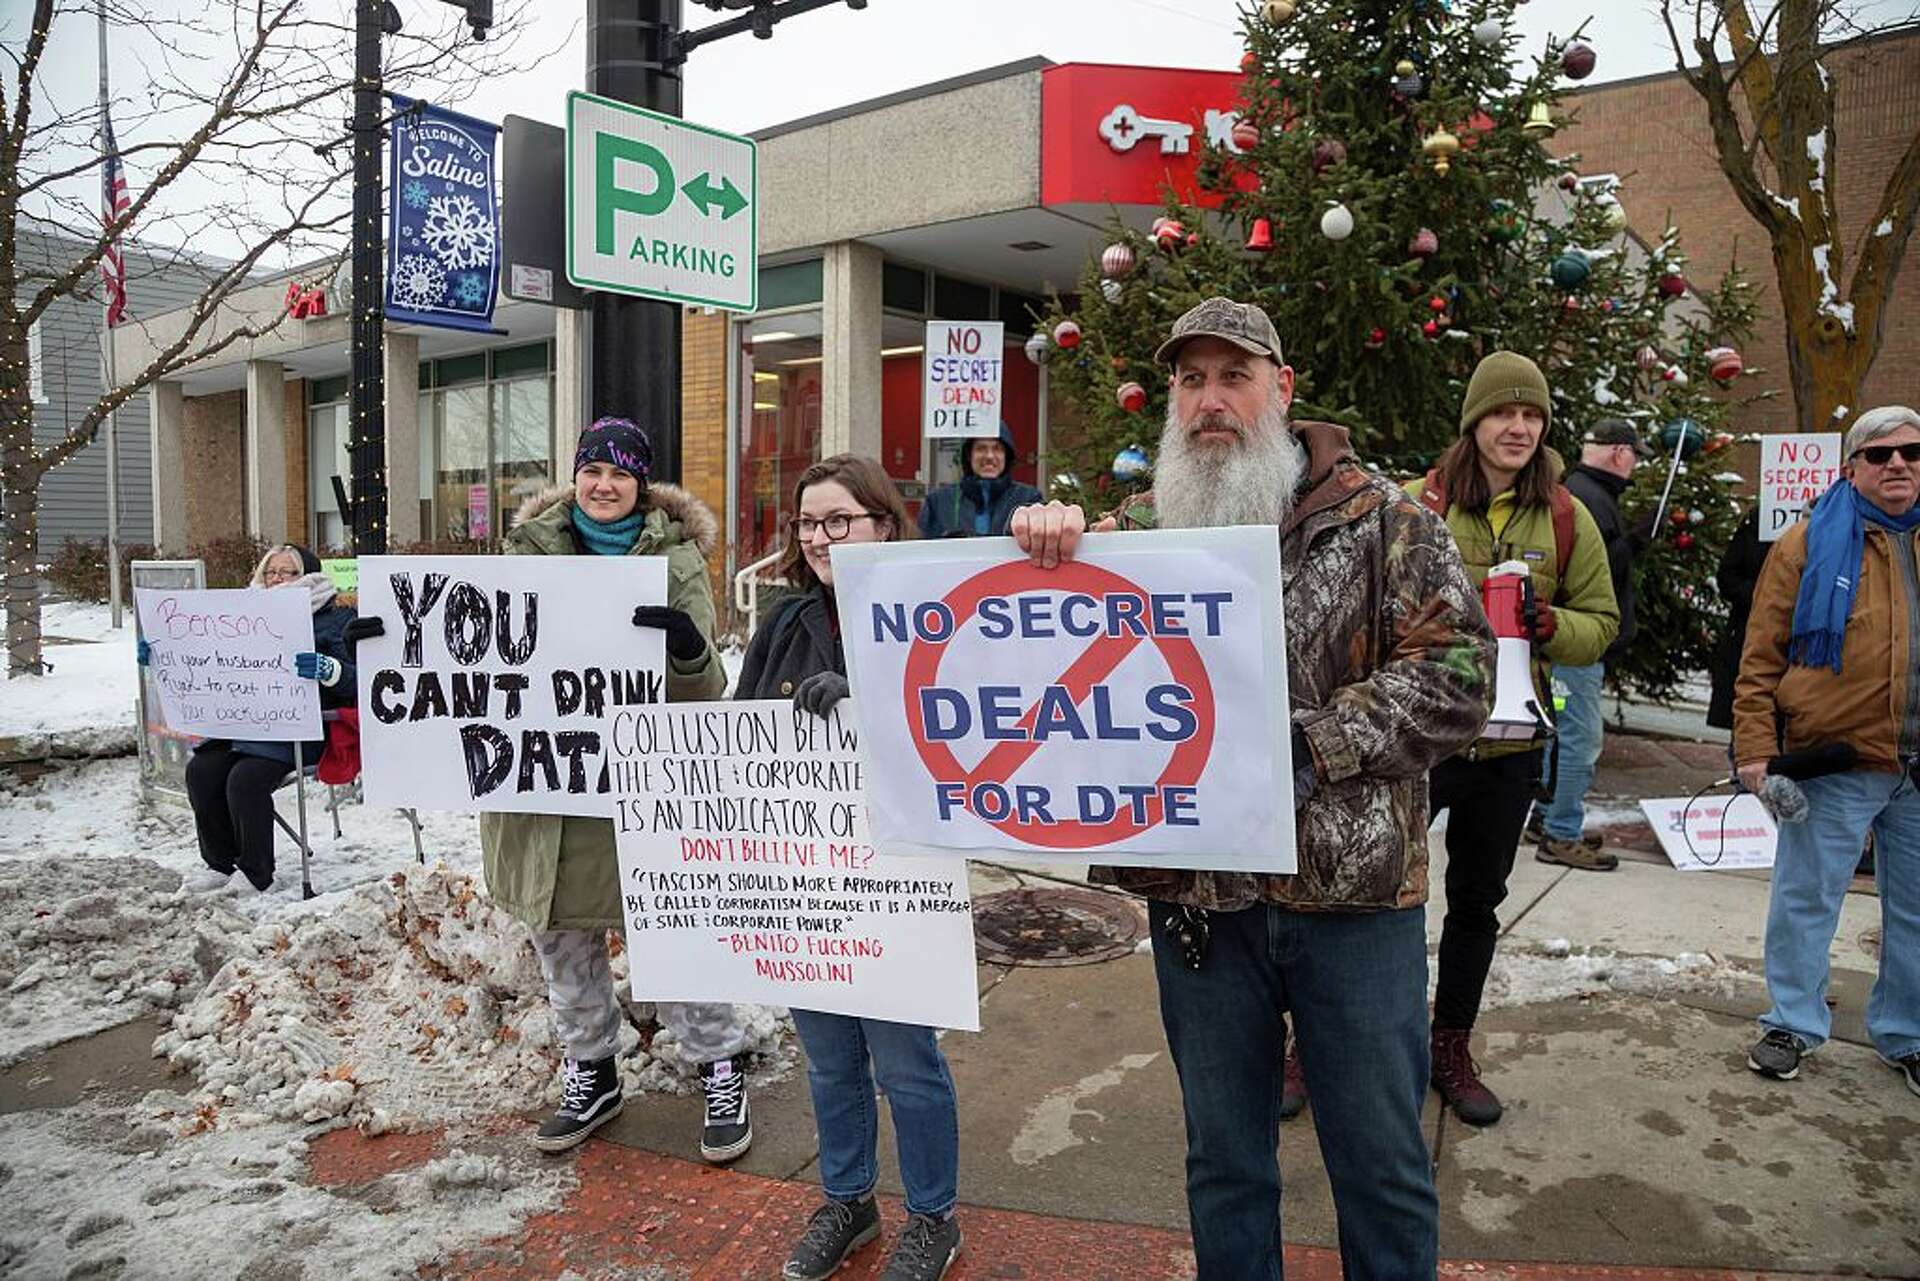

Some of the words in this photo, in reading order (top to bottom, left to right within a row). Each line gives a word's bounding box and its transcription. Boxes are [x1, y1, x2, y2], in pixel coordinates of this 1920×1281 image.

[408, 128, 465, 149] WELCOME
[468, 145, 483, 163] TO
[403, 145, 486, 189] Saline
[947, 327, 981, 355] NO
[931, 358, 1001, 383] SECRET
[943, 387, 996, 405] DEALS
[934, 408, 980, 428] DTE
[1779, 441, 1821, 464] NO
[1764, 467, 1836, 485] SECRET
[157, 598, 283, 640] Benson
[390, 572, 539, 668] YOU
[871, 601, 956, 644] NO
[978, 591, 1233, 639] SECRET
[215, 650, 289, 673] husband
[204, 677, 223, 692] to
[371, 669, 530, 724] CANT
[551, 667, 663, 718] DRINK
[919, 684, 1199, 743] DEALS
[613, 709, 778, 758] COLLUSION
[611, 760, 652, 794] THE
[663, 757, 724, 796] STATE
[746, 760, 864, 792] CORPORATE
[616, 799, 644, 833] IS
[653, 798, 683, 834] AN
[692, 796, 824, 839] INDICATOR
[830, 802, 857, 838] OF
[936, 781, 1056, 824] FOR
[1077, 783, 1200, 826] DTE
[680, 837, 735, 862] DON'T
[741, 838, 819, 866] BELIEVE
[829, 843, 875, 870] ME?
[728, 873, 788, 891] SHOULD
[792, 875, 837, 892] MORE
[843, 876, 954, 897] APPROPRIATELY
[626, 894, 647, 913] BE
[654, 894, 711, 911] CALLED
[807, 898, 864, 913] BECAUSE
[869, 900, 882, 912] IT
[888, 901, 899, 914] IS
[906, 900, 916, 912] A
[634, 917, 651, 931] OF
[656, 914, 699, 929] STATE
[713, 914, 793, 930] CORPORATE
[806, 935, 883, 958] FUCKING
[755, 958, 854, 984] MUSSOLINI
